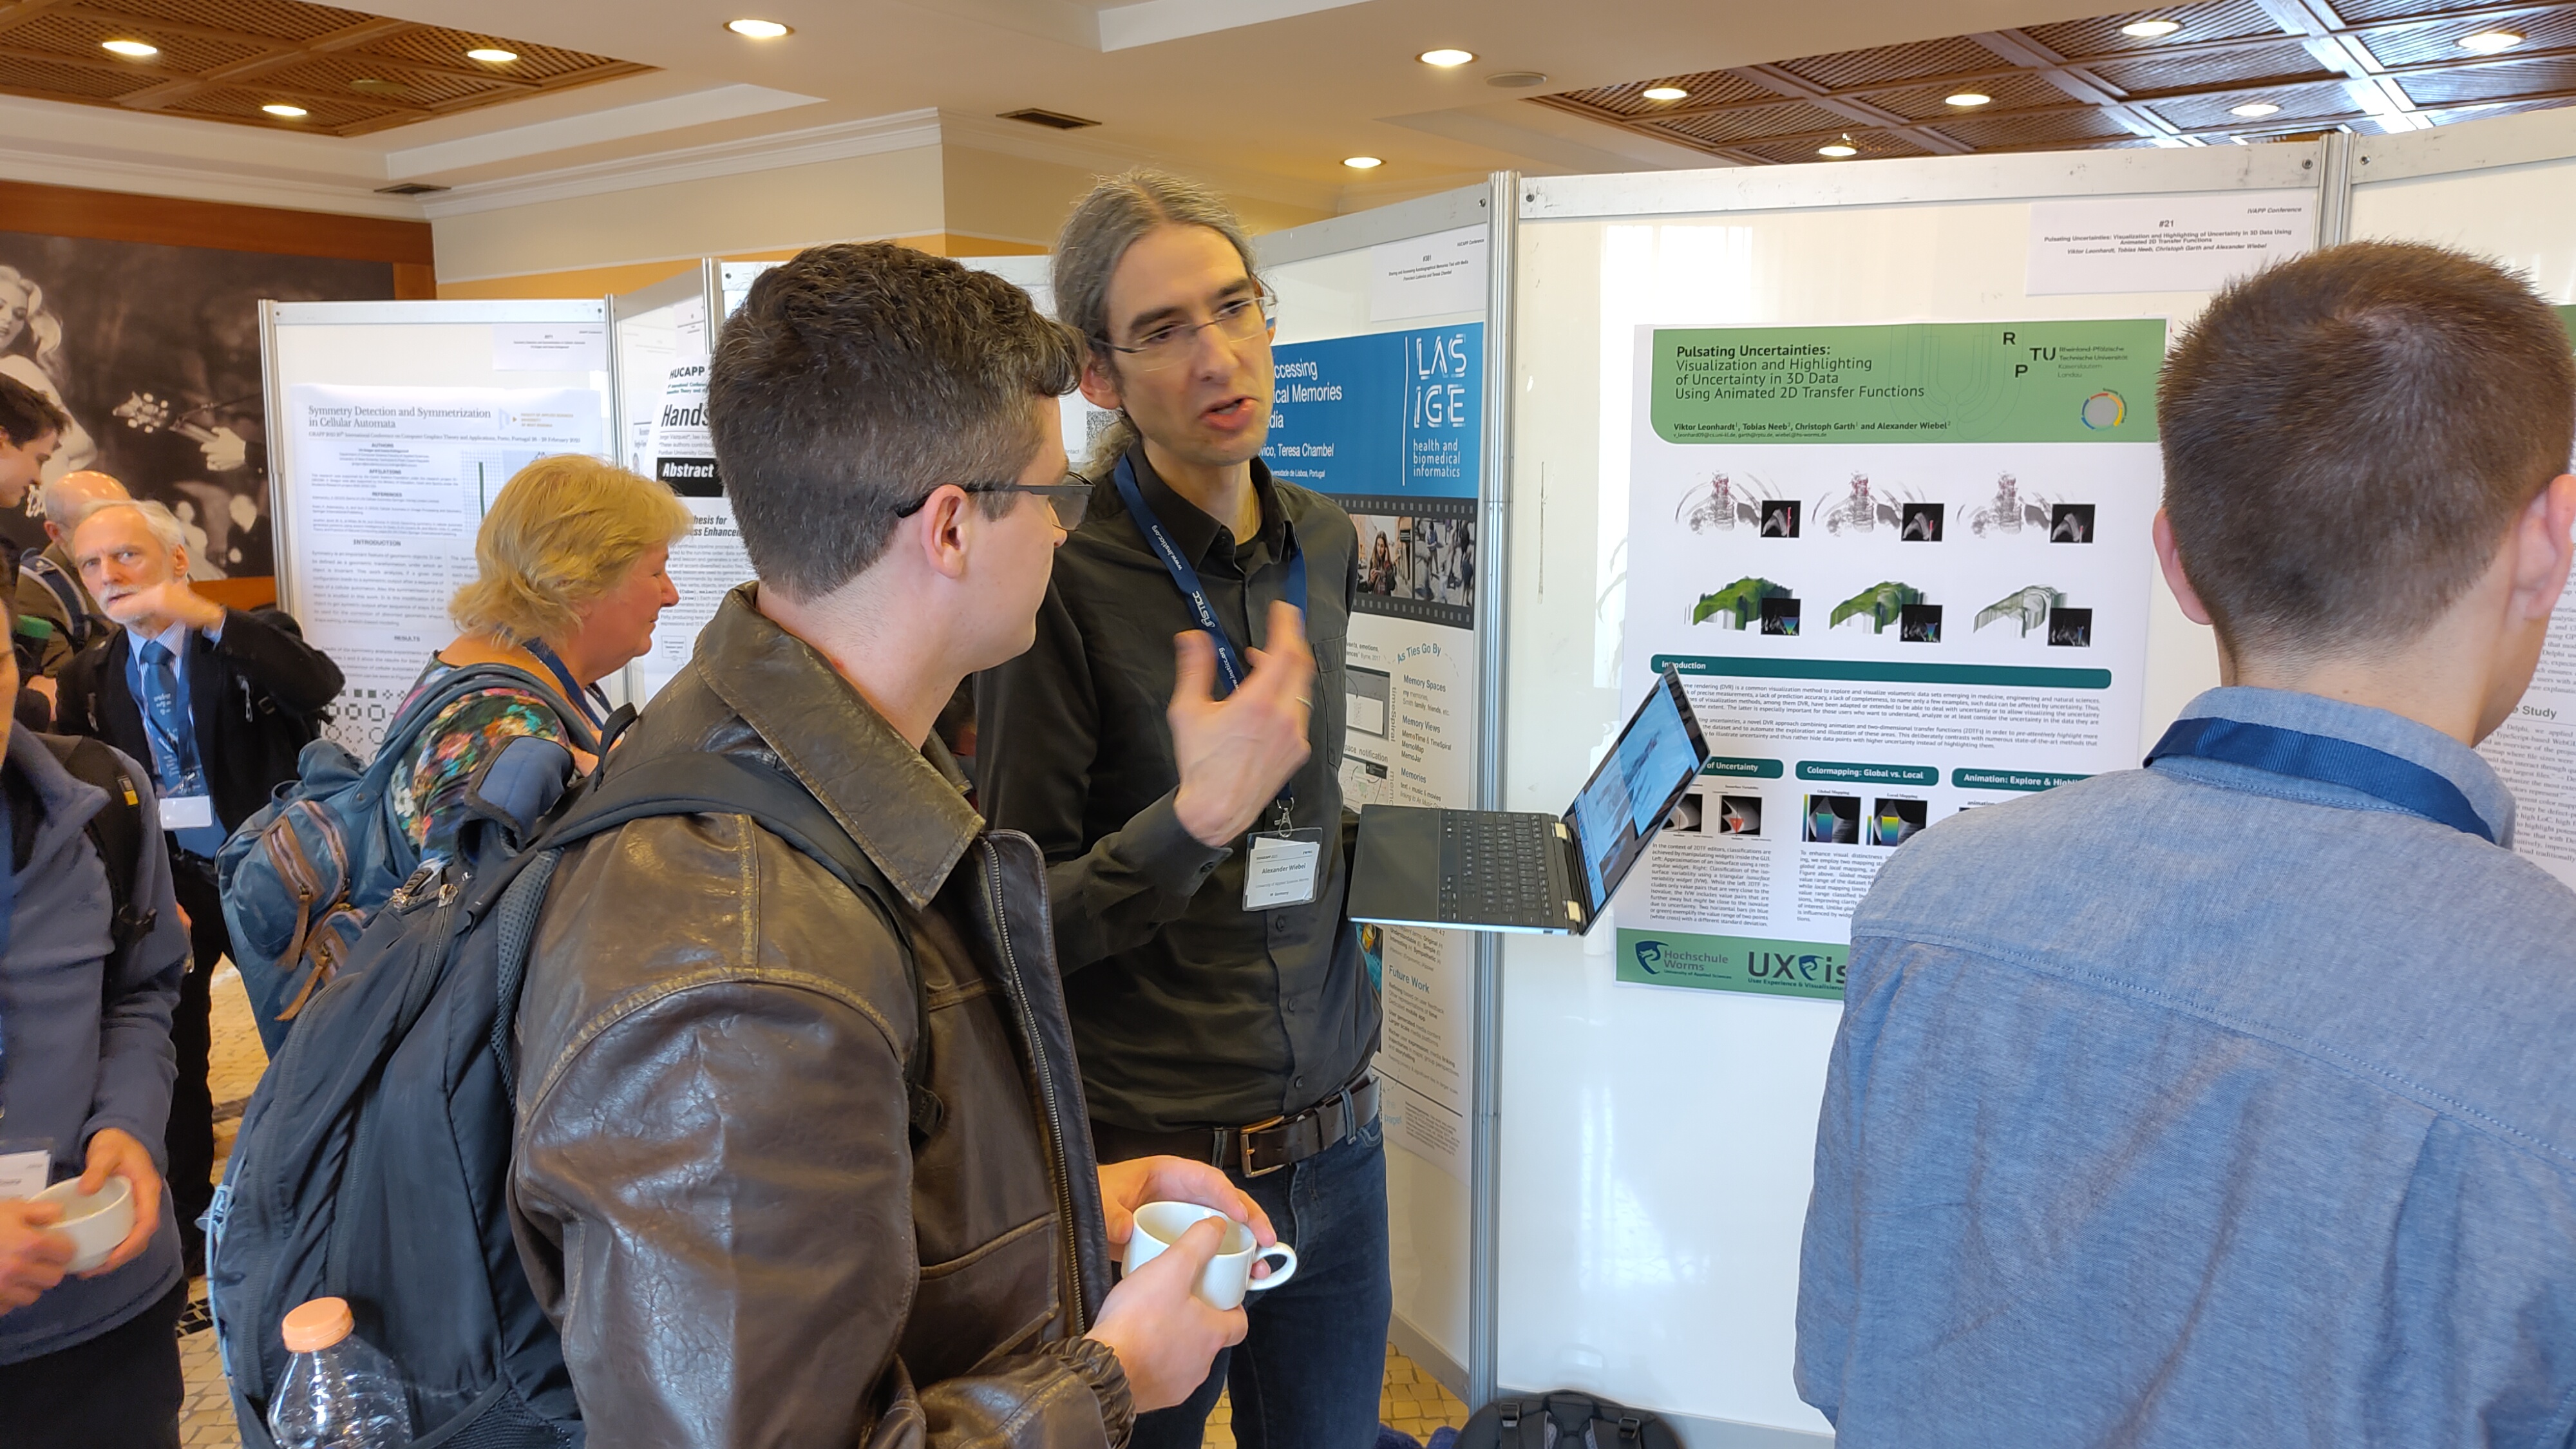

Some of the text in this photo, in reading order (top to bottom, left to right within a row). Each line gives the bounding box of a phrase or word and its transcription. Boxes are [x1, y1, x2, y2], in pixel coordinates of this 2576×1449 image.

[2003, 332, 2016, 345] R
[1416, 334, 1466, 380] LAS
[1677, 344, 1830, 359] Pulsating Uncertainties:
[2029, 347, 2056, 361] TU
[1274, 358, 1318, 381] ccessing
[1676, 357, 1872, 372] Visualization and Highlighting
[2015, 365, 2028, 377] P
[669, 366, 705, 379] HUCAPP
[1676, 372, 1838, 387] of Uncertainty in 3D Data
[1293, 382, 1342, 402] Memories
[1676, 385, 1924, 401] Using Animated 2D Transfer Functions
[308, 406, 491, 419] Symmetry Detection and Symmetrization
[1414, 384, 1465, 428] IGE
[309, 418, 396, 428] in Cellular Automata
[1795, 422, 1832, 431] Christoph
[1278, 444, 1300, 457] Teresa
[1302, 442, 1334, 457] Chambel
[1414, 438, 1457, 451] health and
[1414, 451, 1460, 466] biomedical
[663, 462, 714, 477] Abstract
[1309, 469, 1325, 478] Portugal
[1414, 464, 1460, 477] informatics
[715, 516, 727, 524] for
[1151, 525, 1182, 571] www.insticc.org
[1397, 643, 1441, 664] As Ties Go By
[1662, 661, 1706, 669] Inoduction
[1404, 674, 1446, 692] Memory Spaces
[2522, 705, 2557, 719] Study
[1403, 715, 1441, 733] Memory Views
[1401, 741, 1424, 753] MemoMap
[1402, 730, 1425, 743] MemoTime
[1430, 739, 1451, 750] TimeSpiral
[1359, 748, 1388, 762] notification
[1401, 751, 1421, 762] MemoJar
[1707, 761, 1757, 773] of Uncertainty
[1807, 766, 1862, 778] Colormapping:
[1864, 768, 1888, 777] Global
[1903, 771, 1924, 779] Local
[1401, 768, 1426, 783] Memories
[1964, 774, 2008, 783] Animation:
[2010, 776, 2041, 786] Explore
[1262, 866, 1288, 874] Alexander
[1664, 951, 1728, 963] Hochschule
[1664, 960, 1704, 971] Worms
[1389, 965, 1429, 994] Future Work
[1763, 979, 1797, 987] Experience
